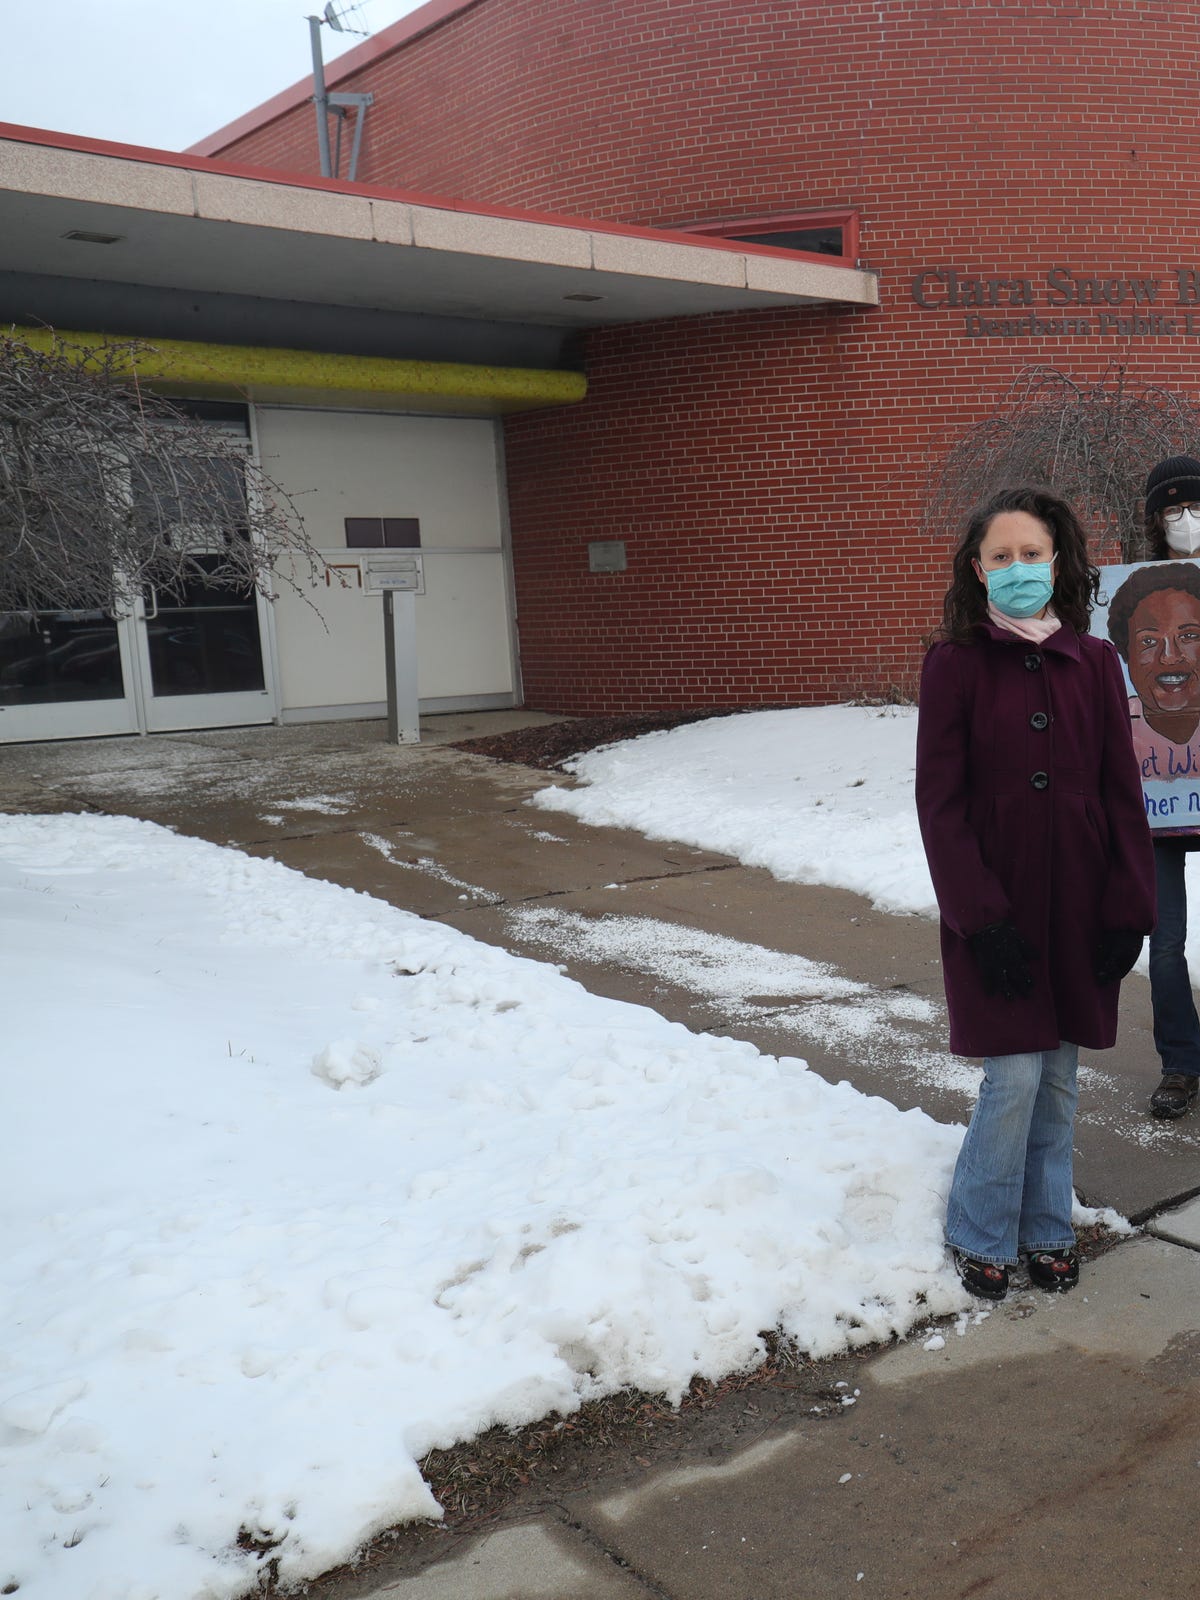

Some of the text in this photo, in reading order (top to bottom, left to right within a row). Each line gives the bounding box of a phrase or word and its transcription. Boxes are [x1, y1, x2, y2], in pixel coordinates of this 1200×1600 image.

[912, 270, 1032, 308] Clara
[1047, 268, 1161, 305] Snow
[965, 314, 1091, 337] Dearborn
[1098, 313, 1176, 336] Public
[1144, 791, 1180, 817] her
